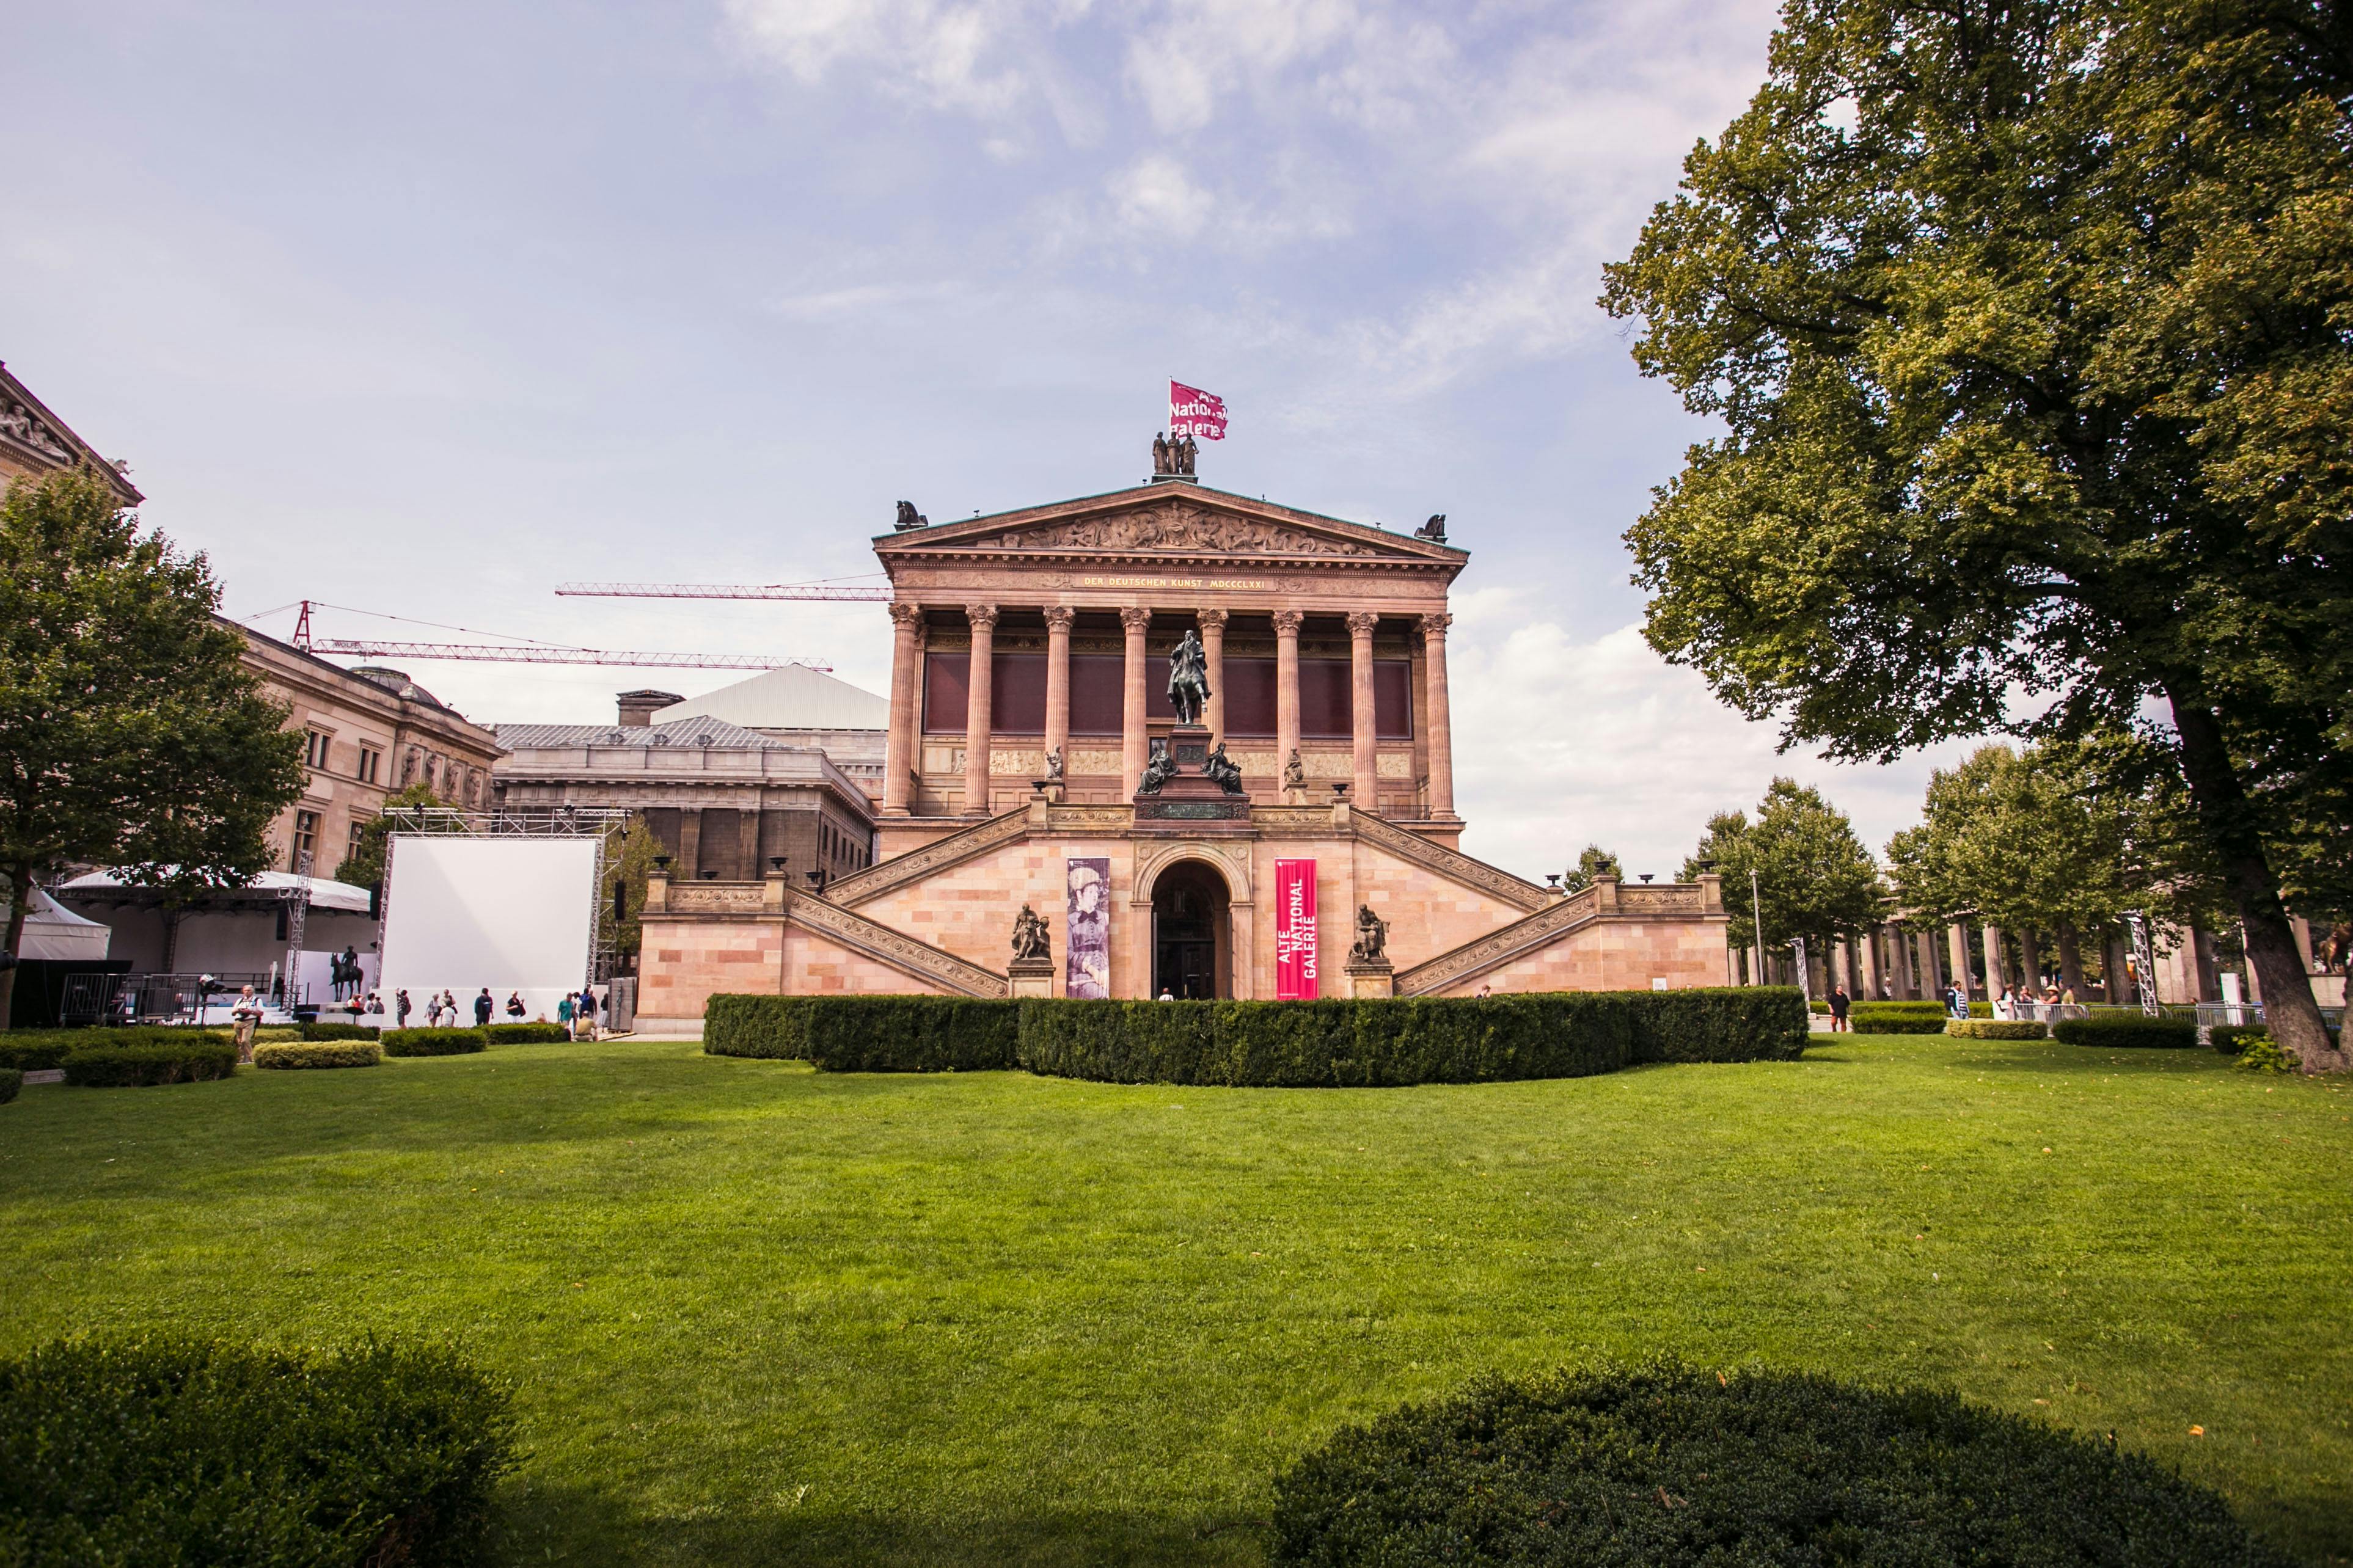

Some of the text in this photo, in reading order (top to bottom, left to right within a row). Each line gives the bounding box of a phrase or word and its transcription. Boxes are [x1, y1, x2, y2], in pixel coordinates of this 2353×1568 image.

[1109, 578, 1166, 586] DEUTSCHEN
[1210, 580, 1265, 588] MDCCCLXXI
[1290, 879, 1303, 951] NATIONAL
[1278, 930, 1290, 964] ALTE
[1303, 916, 1317, 979] GALERIE
